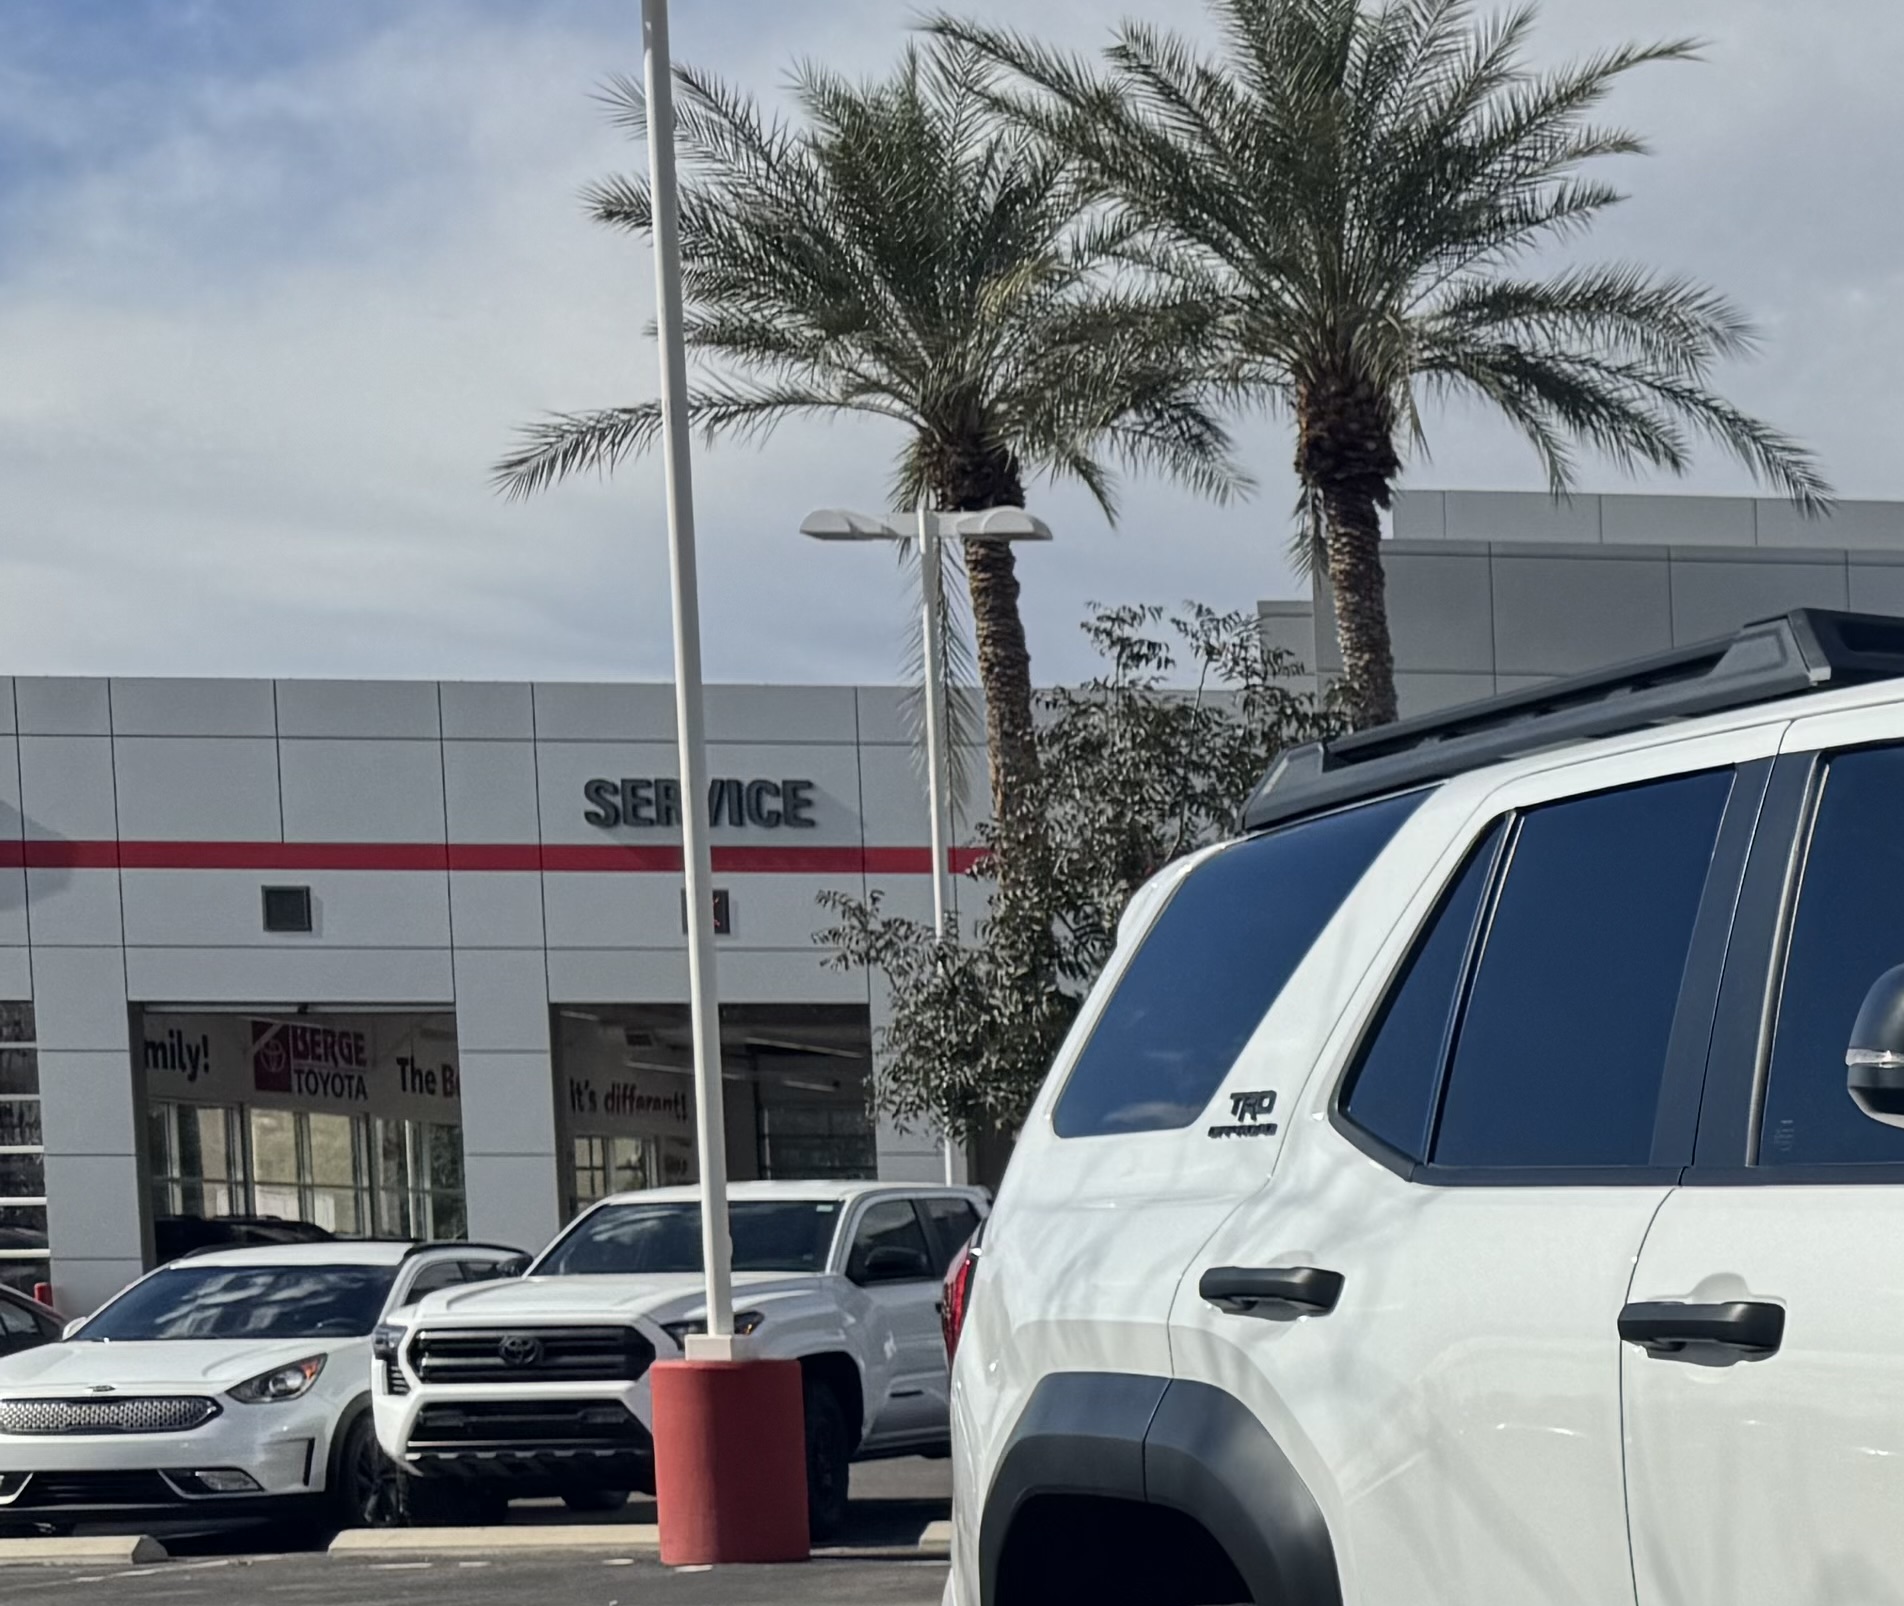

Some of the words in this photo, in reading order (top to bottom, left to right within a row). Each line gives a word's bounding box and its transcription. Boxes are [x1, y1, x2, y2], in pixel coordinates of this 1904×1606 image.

[583, 777, 817, 829] SERVICE
[143, 1028, 209, 1082] mily!
[292, 1026, 367, 1067] BERGE
[293, 1069, 368, 1101] TOYOTA
[396, 1055, 436, 1096] The
[441, 1063, 460, 1098] B
[569, 1077, 598, 1113] It's
[1230, 1090, 1277, 1123] TRD
